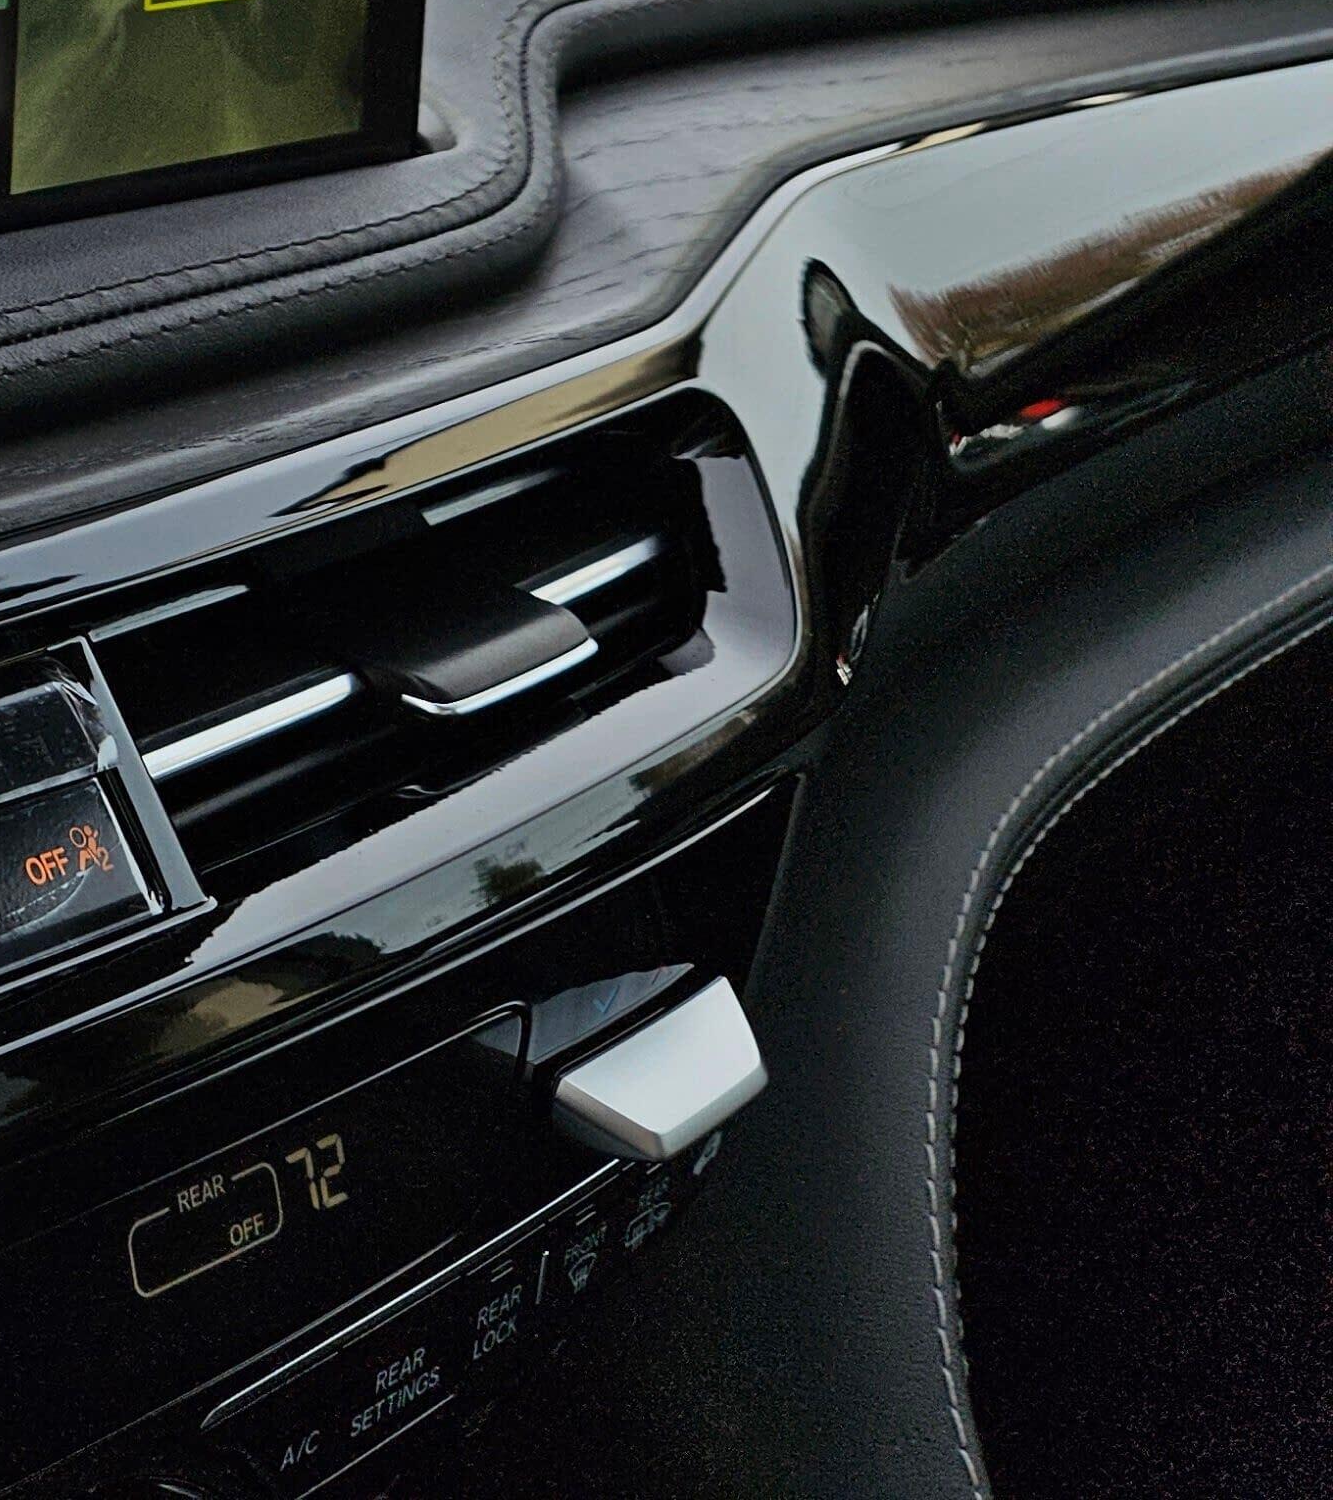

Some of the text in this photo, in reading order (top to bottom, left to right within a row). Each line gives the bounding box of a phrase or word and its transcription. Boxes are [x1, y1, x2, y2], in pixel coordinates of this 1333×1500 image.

[24, 846, 71, 888] OFF
[176, 1173, 227, 1213] REAR
[285, 1133, 349, 1211] 72
[229, 1213, 266, 1248] OFF
[476, 1284, 523, 1330] REAR
[472, 1315, 518, 1361] LOCK
[375, 1346, 426, 1393] REAR
[350, 1366, 441, 1438] SETTINGS
[279, 1430, 321, 1471] A/C
